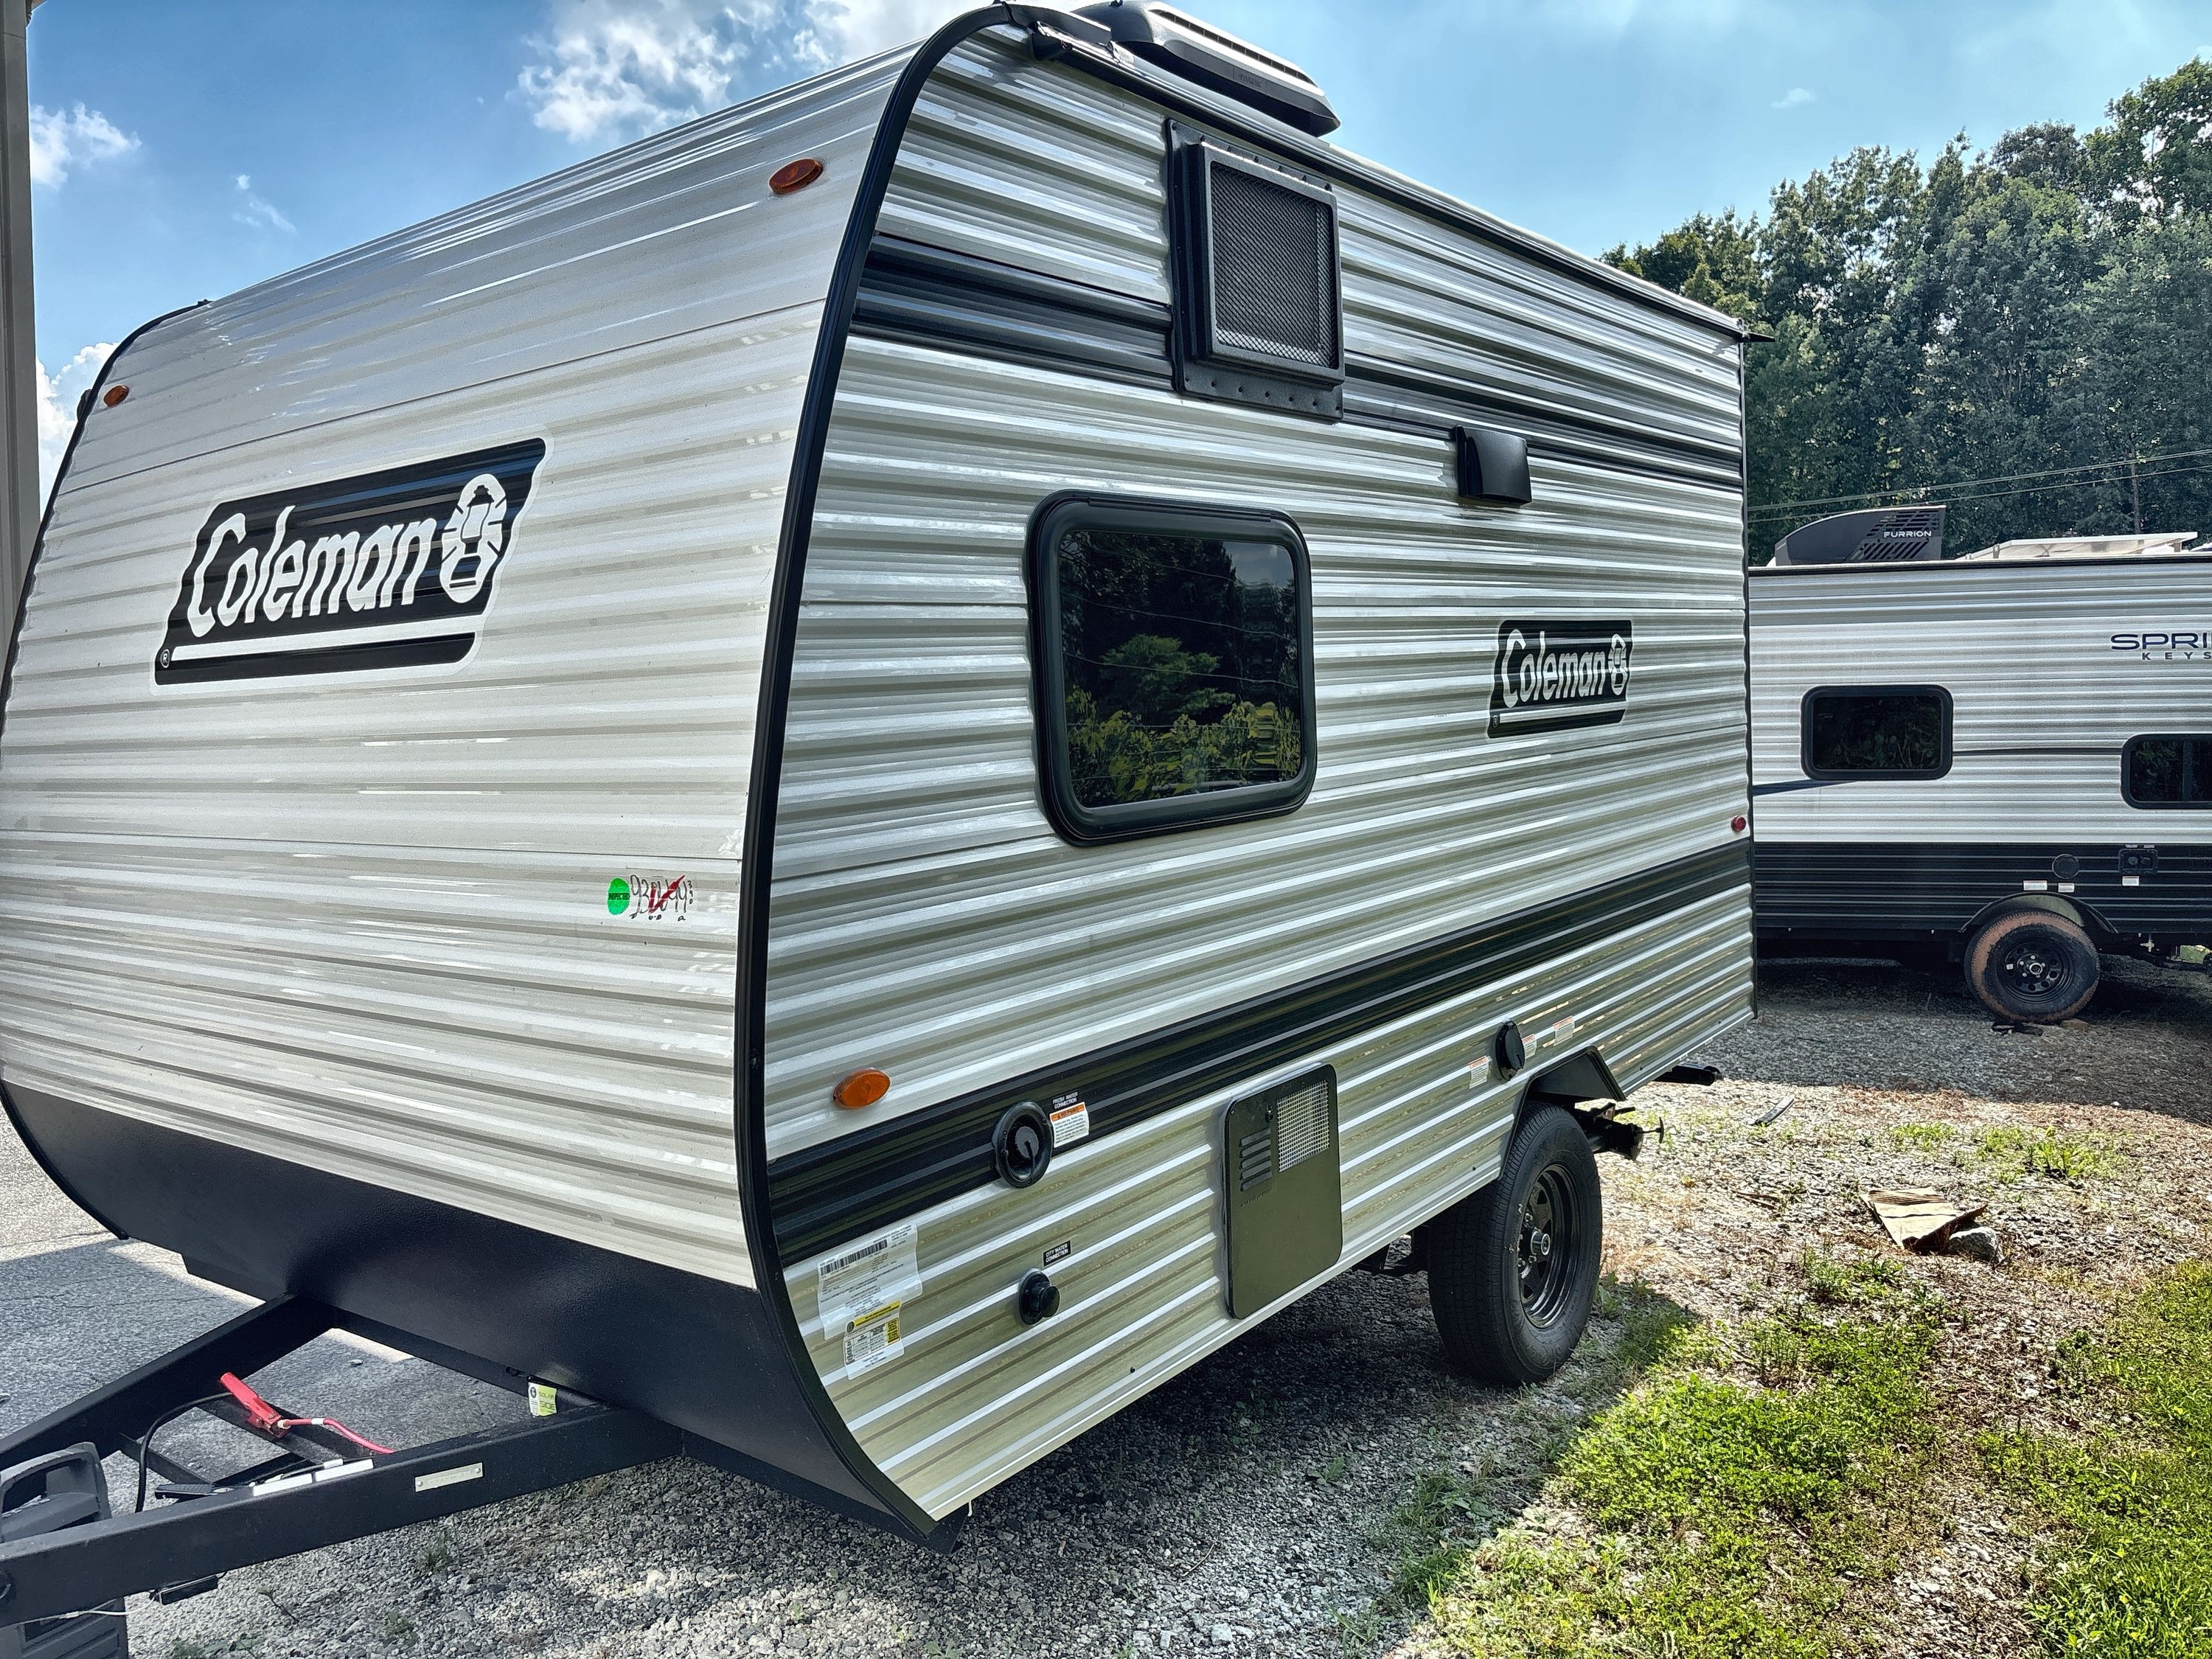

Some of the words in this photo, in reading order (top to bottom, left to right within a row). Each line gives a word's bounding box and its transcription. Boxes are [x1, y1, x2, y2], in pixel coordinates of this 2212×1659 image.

[1883, 530, 1932, 538] FURRION
[187, 505, 437, 638] Coleman
[2110, 632, 2212, 650] SPRI
[1501, 629, 1606, 708] Coleman
[1052, 1096, 1065, 1105] FRESH
[1065, 1091, 1078, 1100] WATER
[1054, 1097, 1077, 1109] CONNECTION
[1046, 1249, 1054, 1257] CITY
[1054, 1243, 1068, 1253] WATER
[1046, 1248, 1069, 1262] CONNECTION
